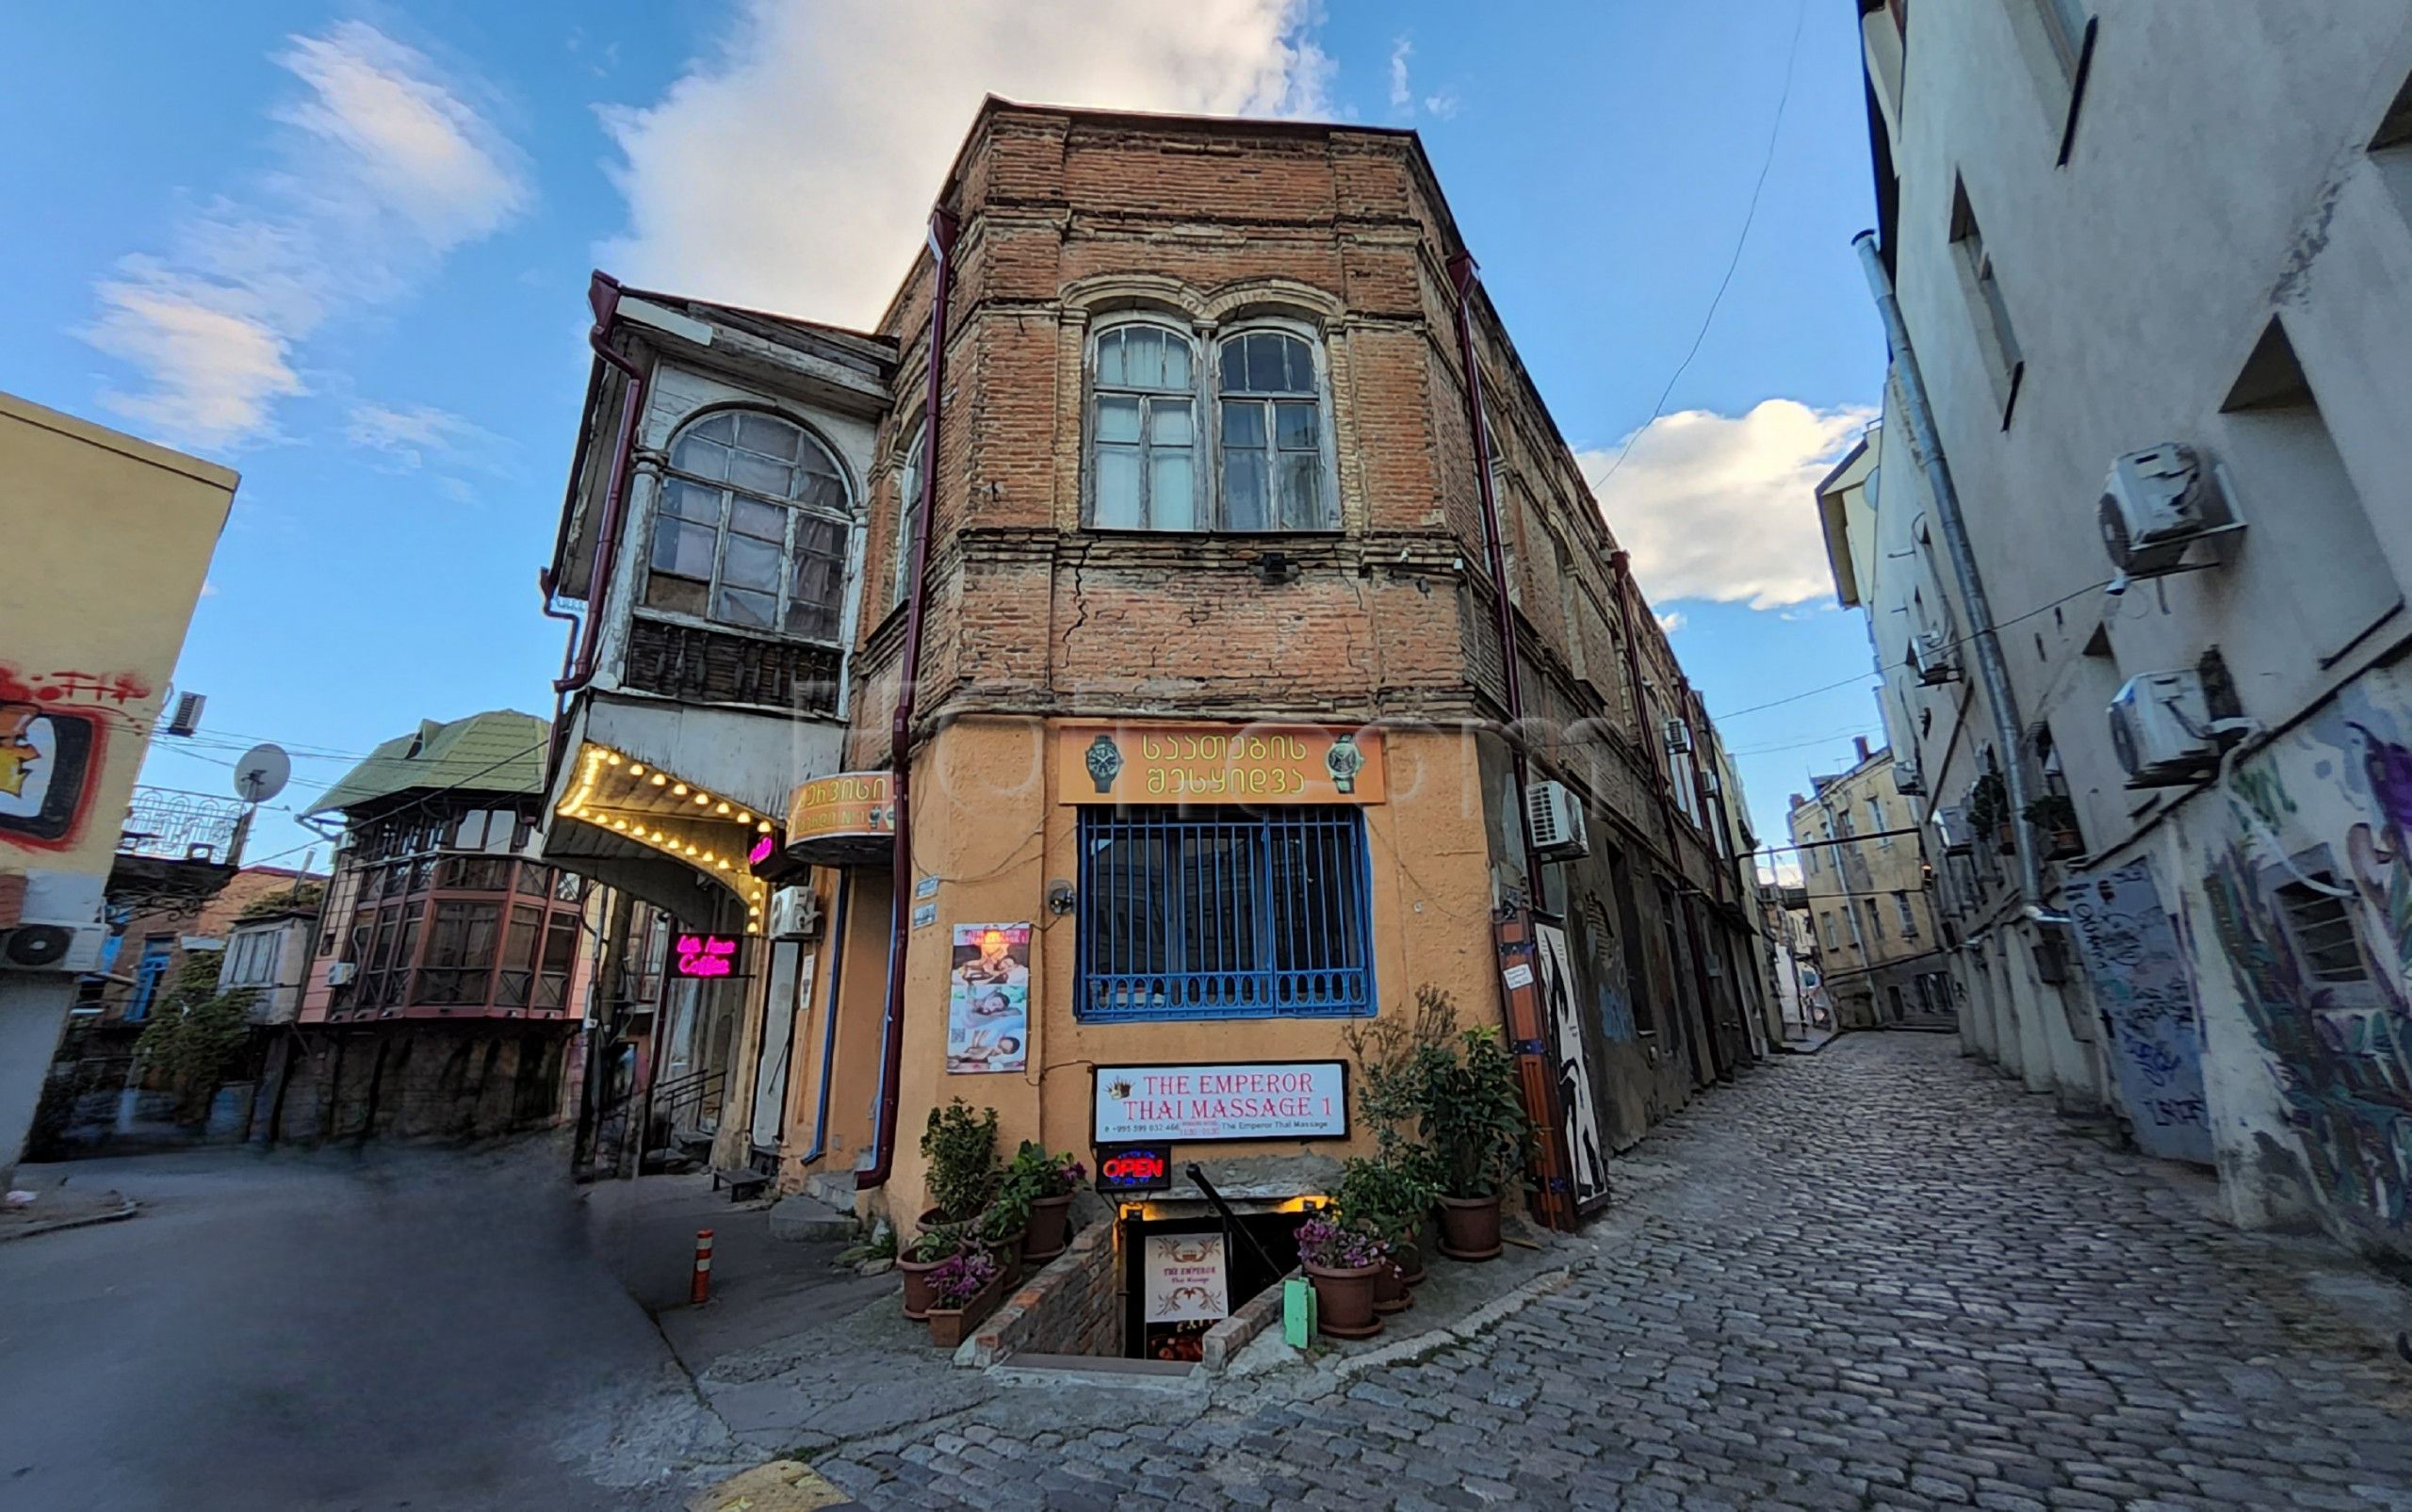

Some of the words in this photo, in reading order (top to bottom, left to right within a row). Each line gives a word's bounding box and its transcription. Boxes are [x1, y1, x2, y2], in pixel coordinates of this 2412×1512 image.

[1142, 734, 1308, 761] საათების
[1147, 768, 1306, 795] შესყიდვა
[1143, 1076, 1191, 1096] THE
[1199, 1073, 1313, 1095] EMPEROR
[1123, 1099, 1185, 1120] THAI
[1191, 1097, 1312, 1118] MASSAGE
[1322, 1097, 1331, 1116] 1
[1221, 1121, 1236, 1130] The
[1238, 1121, 1272, 1130] Emperor
[1294, 1119, 1328, 1129] Massage
[1102, 1158, 1164, 1178] OPEN
